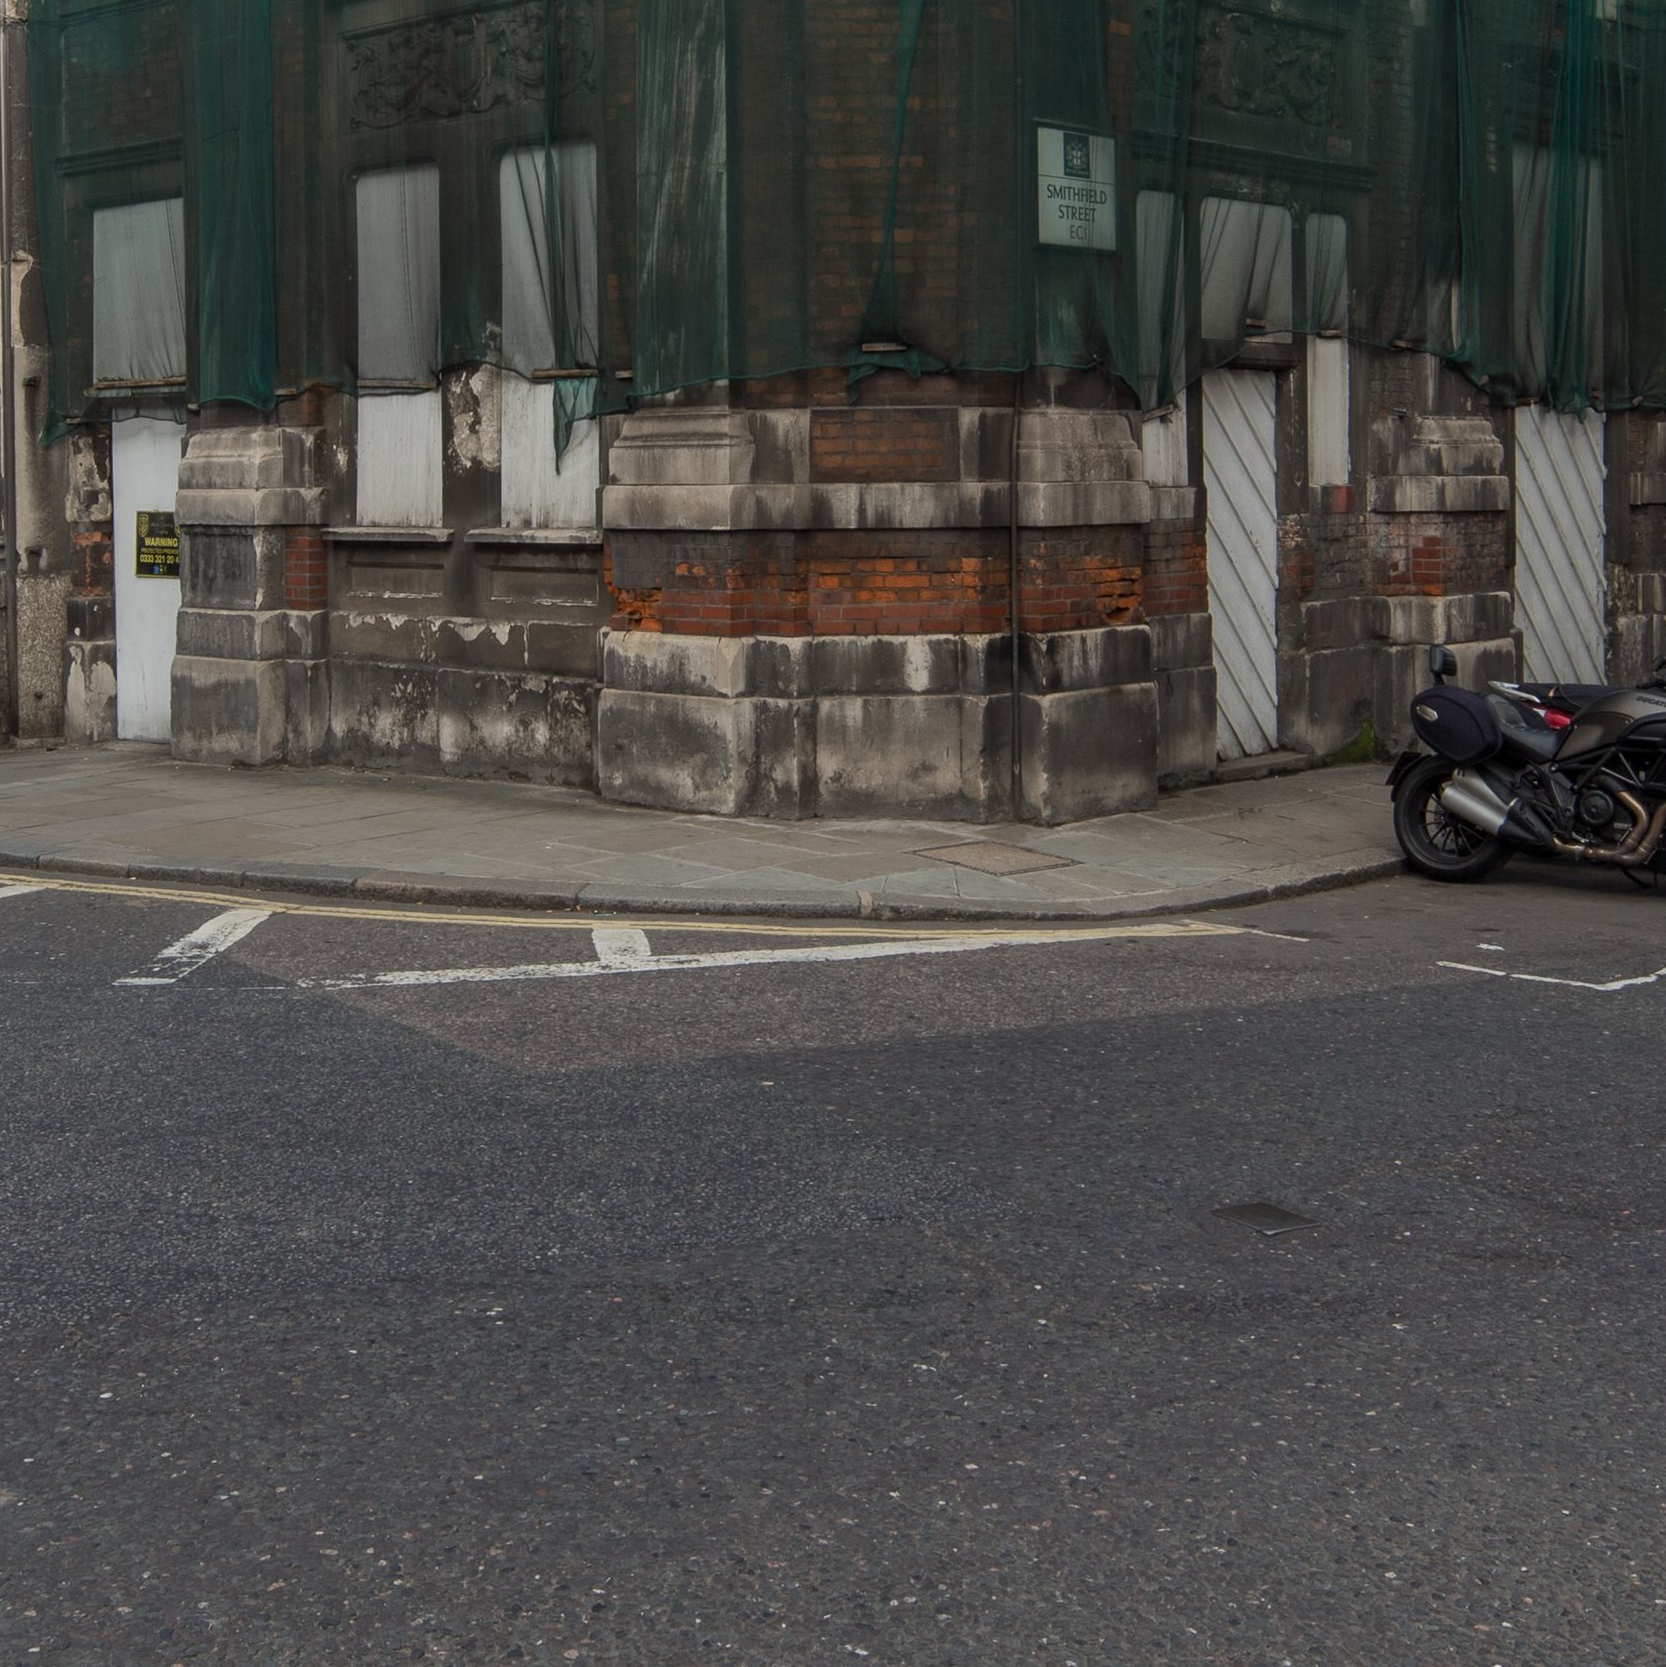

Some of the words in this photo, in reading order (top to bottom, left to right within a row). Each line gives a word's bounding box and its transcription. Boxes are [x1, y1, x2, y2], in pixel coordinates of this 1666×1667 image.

[1046, 184, 1107, 205] SMITHFIELD
[1058, 204, 1097, 223] STREET
[144, 537, 178, 547] WARNING
[140, 554, 154, 563] 0333
[155, 555, 165, 563] 321
